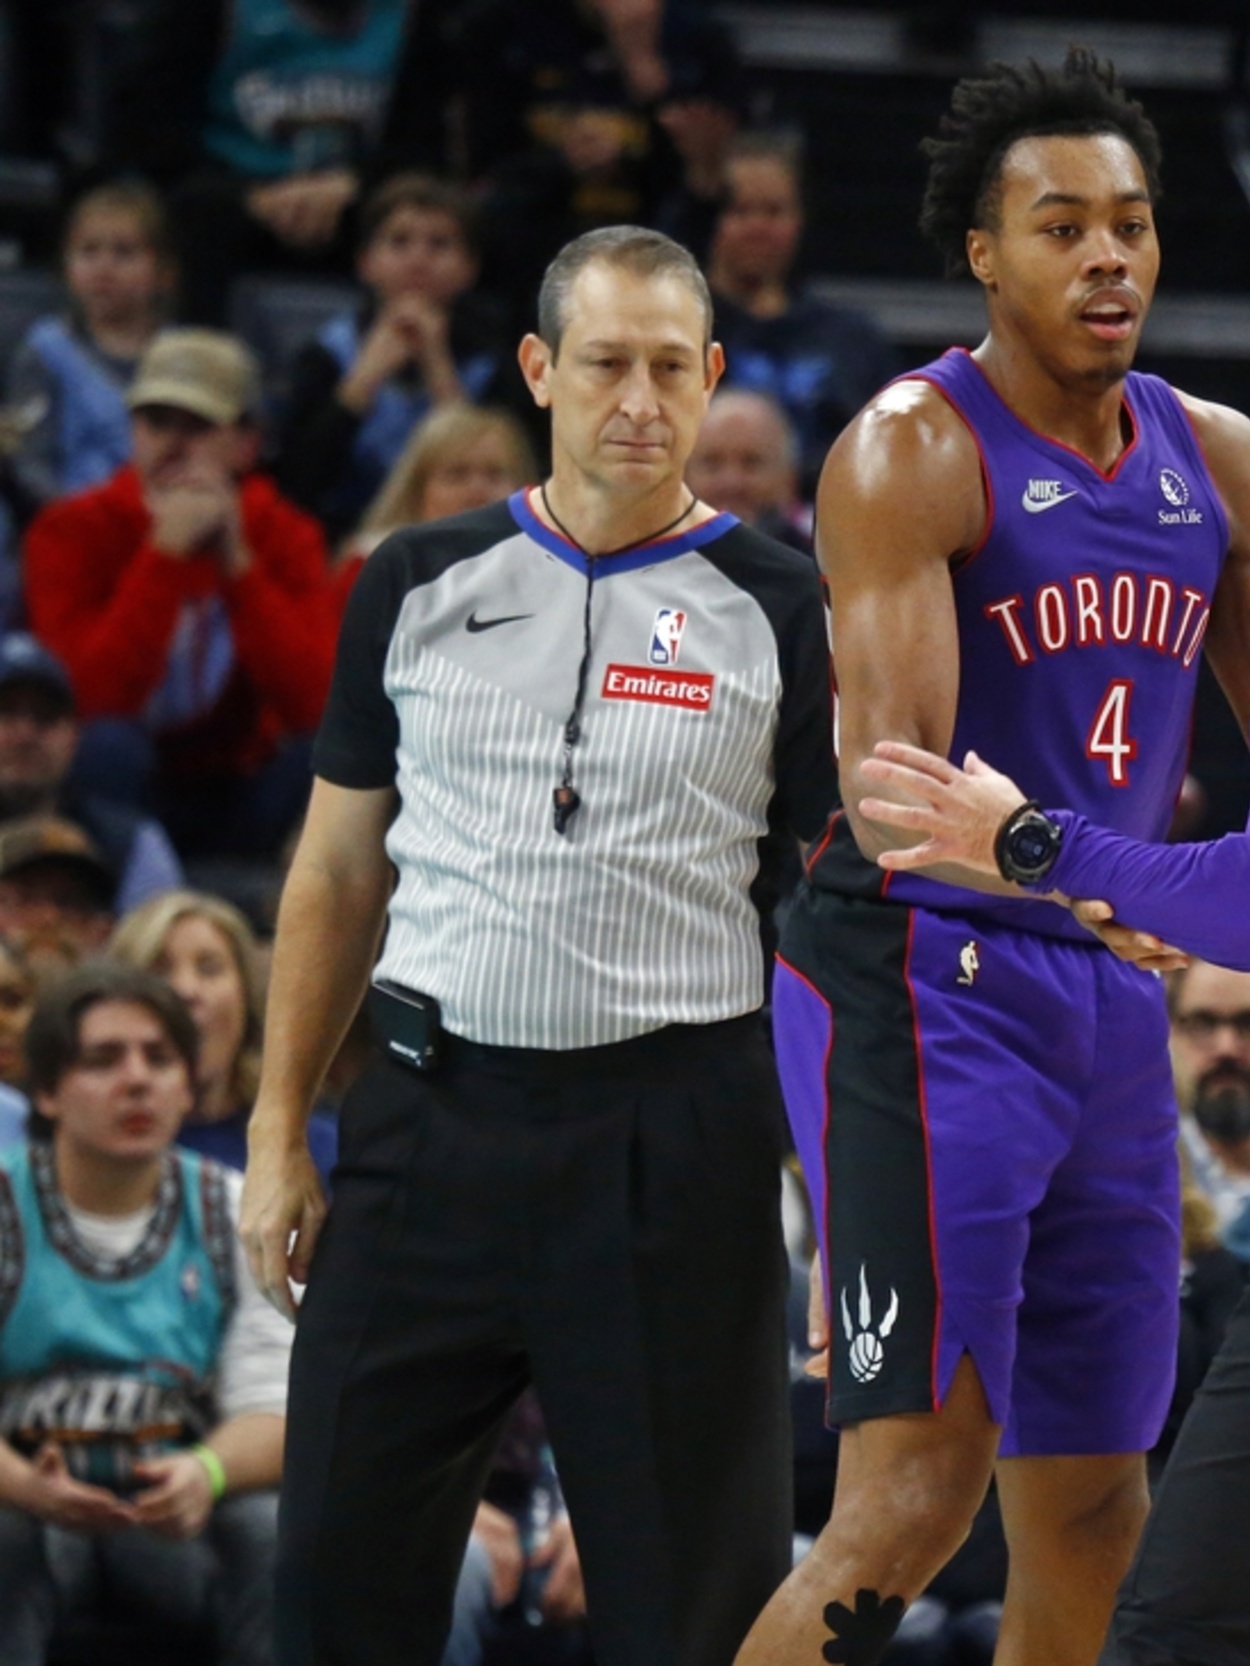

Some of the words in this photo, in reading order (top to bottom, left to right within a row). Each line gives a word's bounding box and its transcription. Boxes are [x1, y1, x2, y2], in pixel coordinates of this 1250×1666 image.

[1028, 479, 1061, 500] NIKE
[1157, 509, 1180, 524] Sun
[606, 671, 711, 703] Emirates
[1085, 678, 1138, 787] 4
